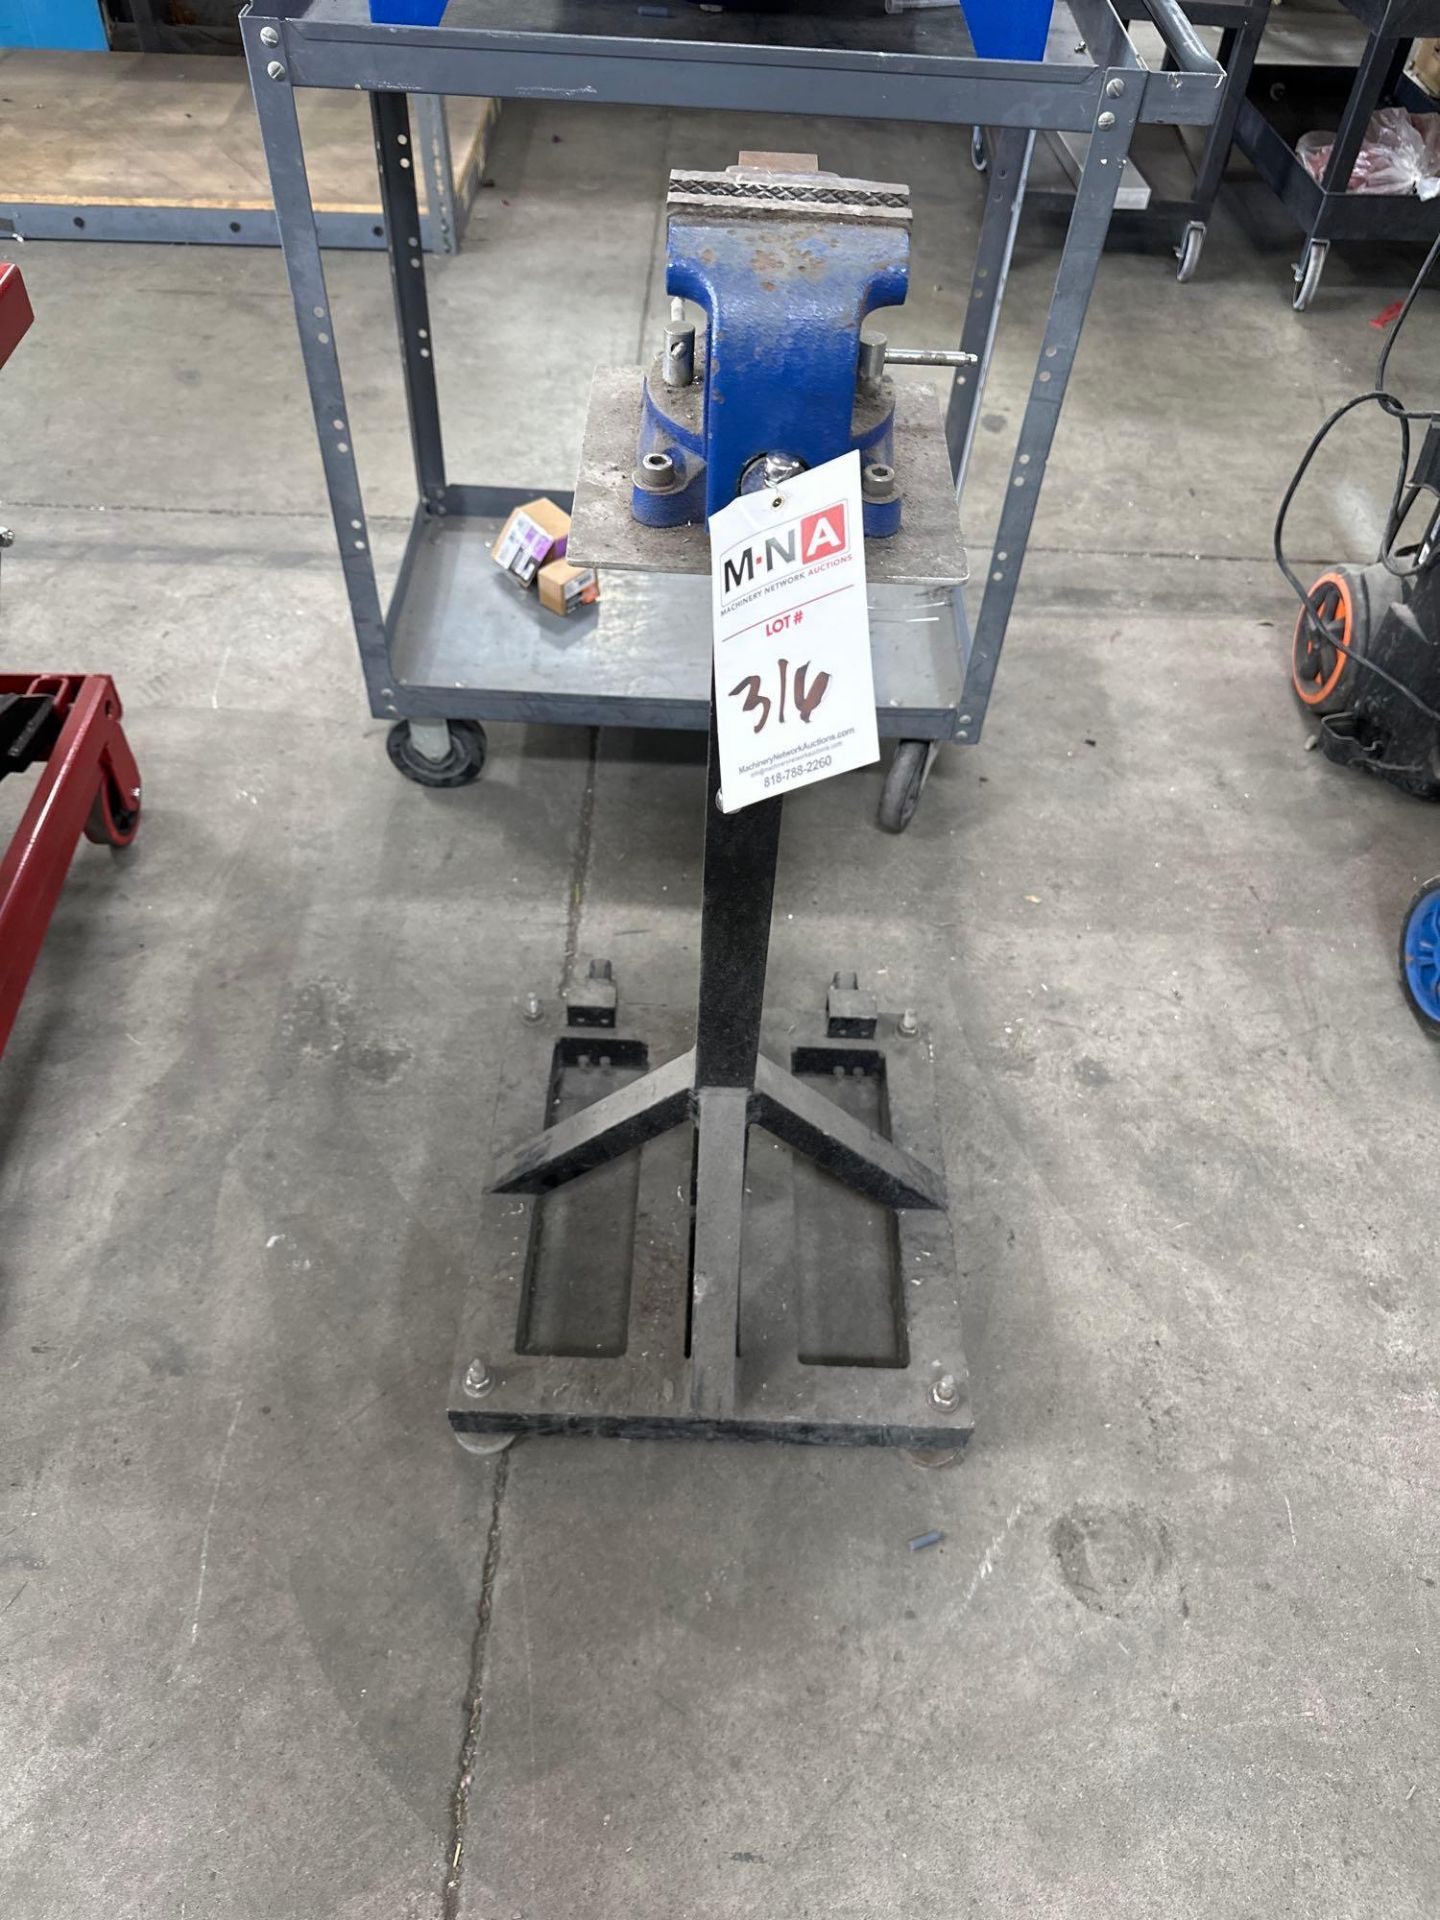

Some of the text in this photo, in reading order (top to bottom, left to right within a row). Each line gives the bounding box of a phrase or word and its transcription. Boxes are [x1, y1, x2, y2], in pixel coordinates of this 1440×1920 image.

[720, 554, 853, 617] MACHINERY NETWORK AUCTIONS
[765, 610, 804, 637] LOT #
[728, 658, 832, 734] 316
[738, 727, 856, 775] MachineryNetworkAuctions.com
[763, 755, 833, 788] 818-788-2260
